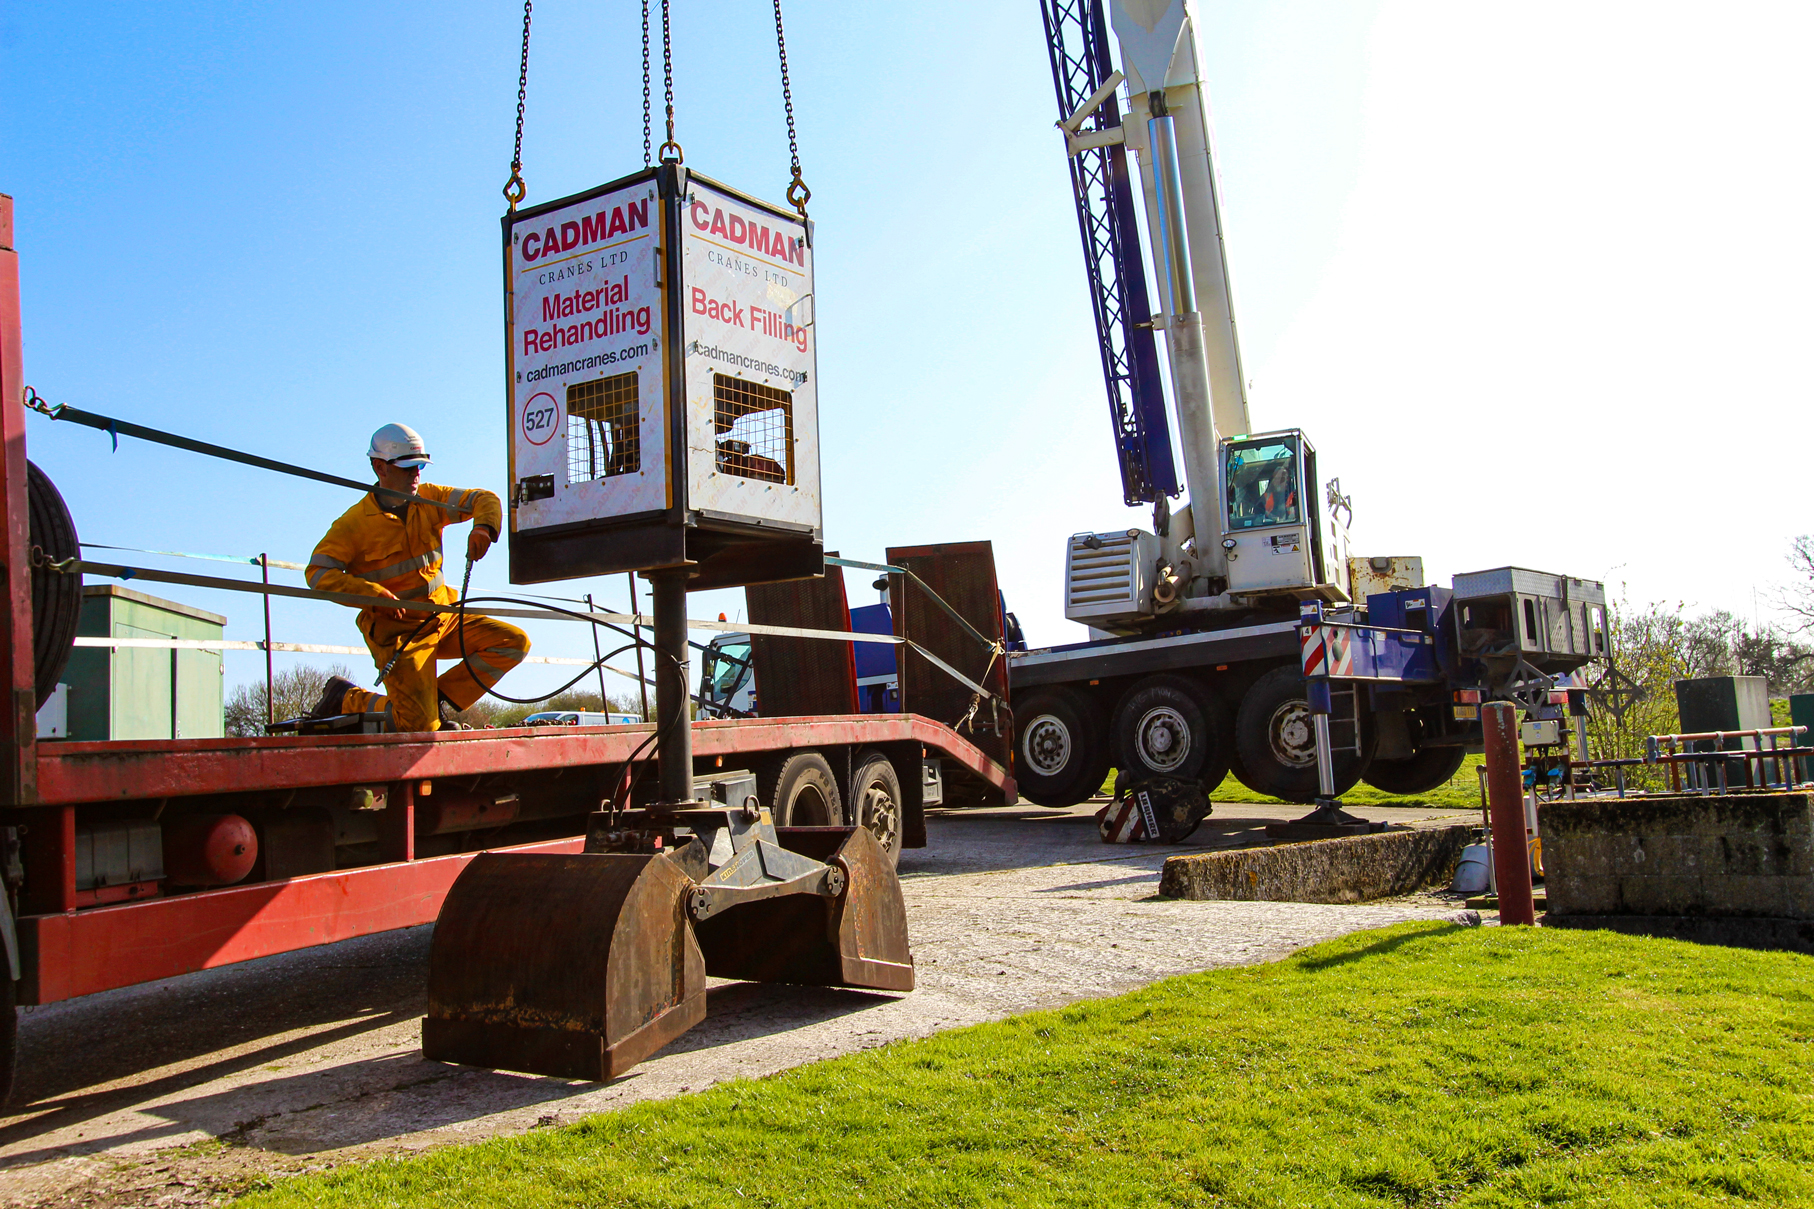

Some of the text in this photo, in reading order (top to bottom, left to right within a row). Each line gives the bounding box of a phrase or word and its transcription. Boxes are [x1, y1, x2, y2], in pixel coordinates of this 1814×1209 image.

[521, 198, 649, 262] CADMAN
[690, 200, 804, 268] CADMAN
[539, 250, 628, 285] CRANES LTD
[708, 250, 788, 287] CRANES LTD
[542, 274, 629, 322] Material
[523, 305, 651, 356] Rehandling
[692, 286, 808, 353] Back Filling
[526, 343, 649, 383] cadmancranes.com
[696, 343, 807, 382] cadmancranes.com
[525, 408, 554, 432] 527
[1304, 627, 1310, 635] 4
[1140, 794, 1158, 836] LIEBHERR
